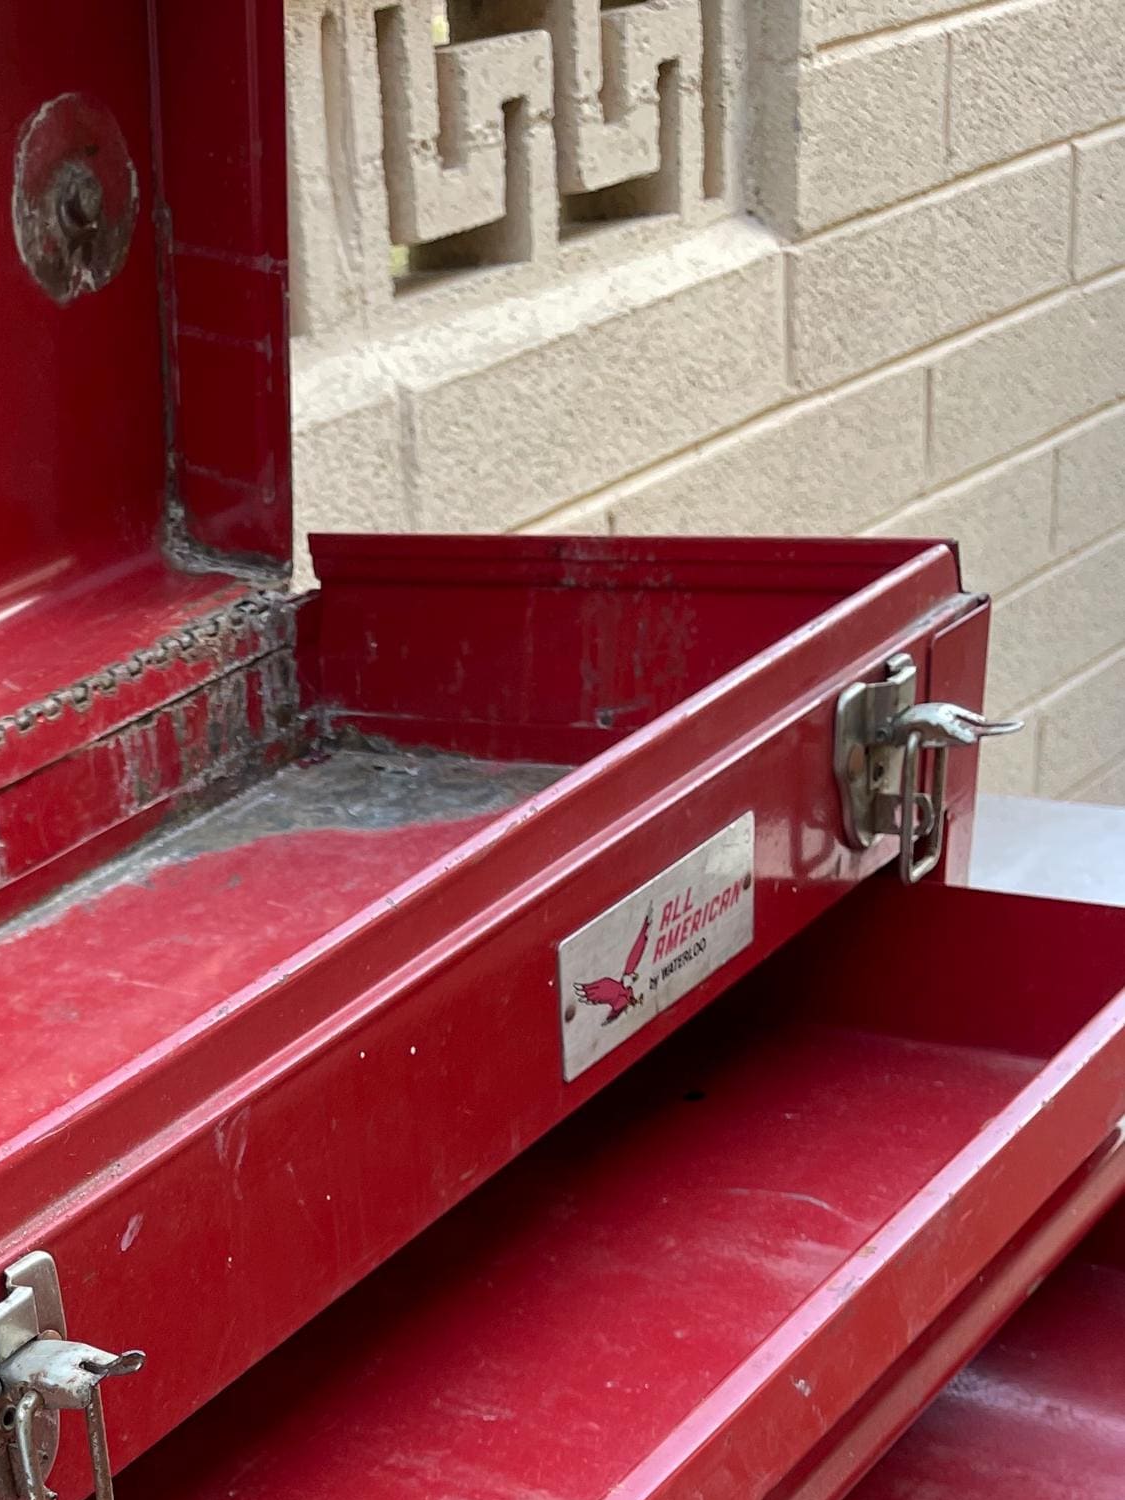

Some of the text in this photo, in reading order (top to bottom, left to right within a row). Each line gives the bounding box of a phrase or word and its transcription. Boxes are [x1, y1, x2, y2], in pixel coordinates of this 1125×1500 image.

[652, 878, 743, 965] AMERICAN
[659, 886, 693, 932] ALL
[649, 937, 707, 990] by WATERLOO
